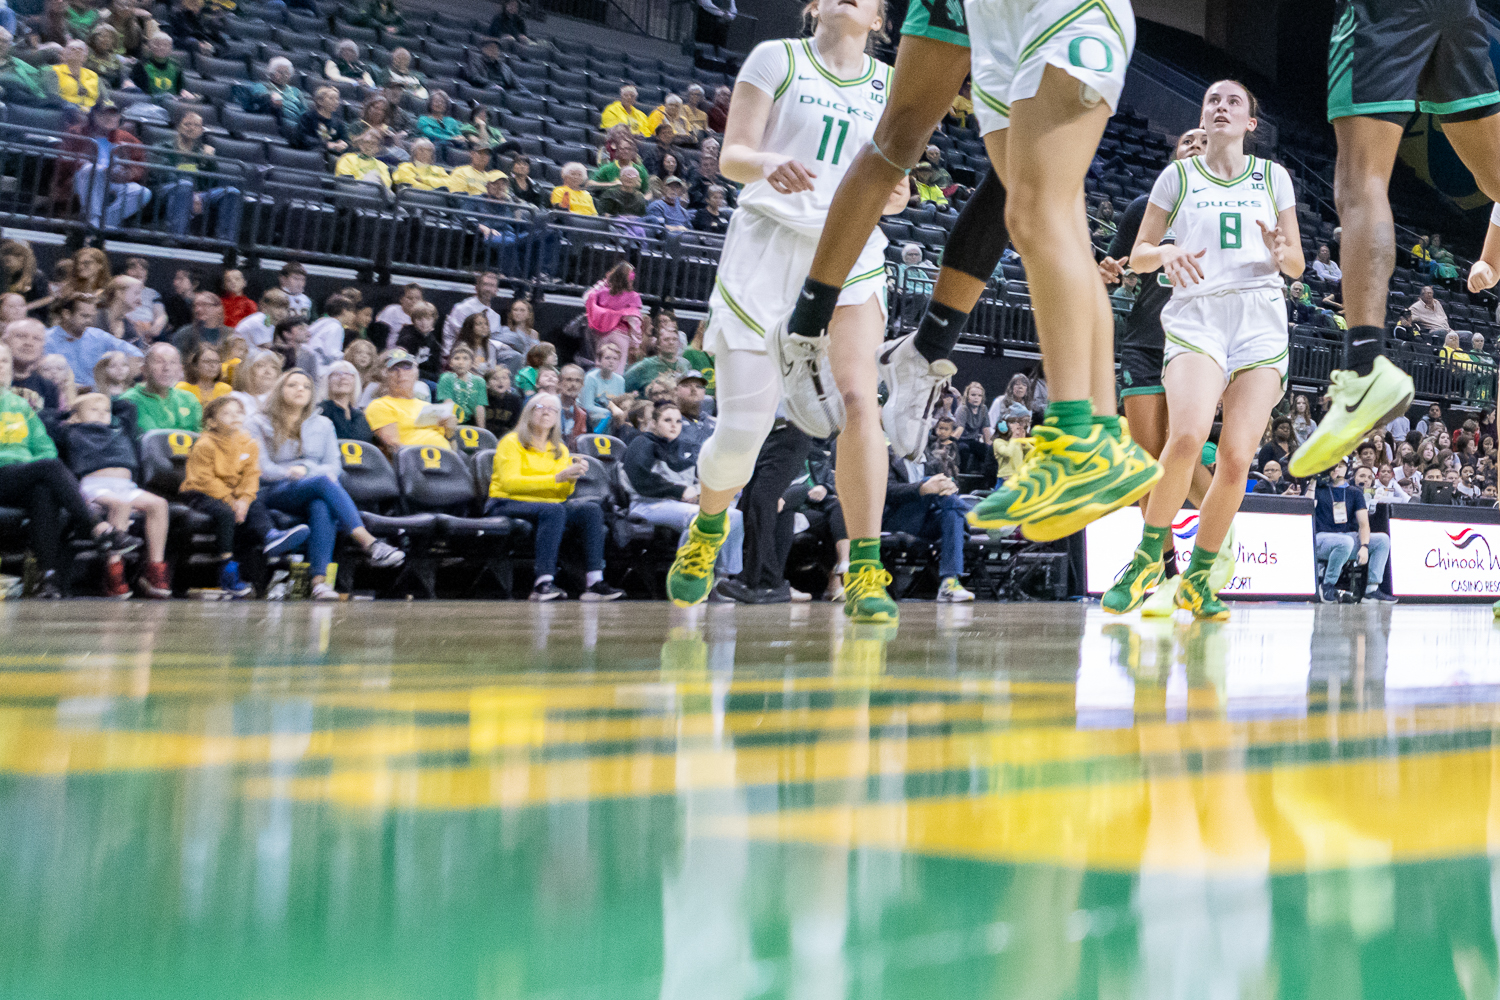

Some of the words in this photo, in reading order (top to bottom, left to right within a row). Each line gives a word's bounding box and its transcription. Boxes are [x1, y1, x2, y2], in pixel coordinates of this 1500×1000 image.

[800, 95, 874, 122] DUCKS
[816, 115, 850, 165] 11
[1196, 200, 1262, 209] DUCKS
[1220, 212, 1242, 249] 8
[1425, 547, 1485, 571] Chinook
[1451, 580, 1483, 593] CASINO
